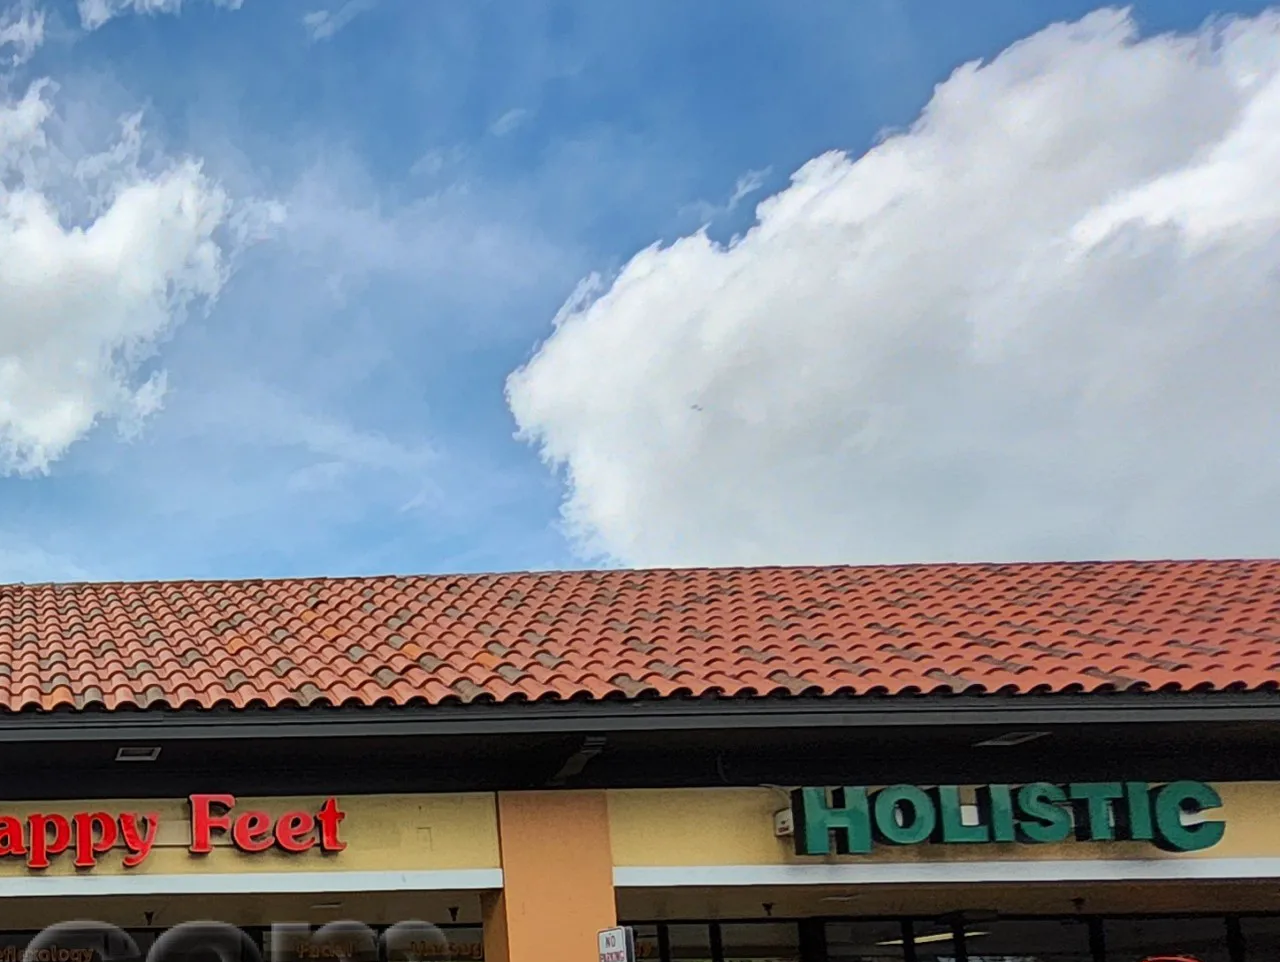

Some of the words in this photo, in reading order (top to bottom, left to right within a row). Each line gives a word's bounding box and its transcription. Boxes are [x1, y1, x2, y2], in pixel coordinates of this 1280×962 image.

[189, 794, 348, 854] Feet
[798, 780, 1227, 856] HOLISTIC
[605, 935, 616, 949] NO
